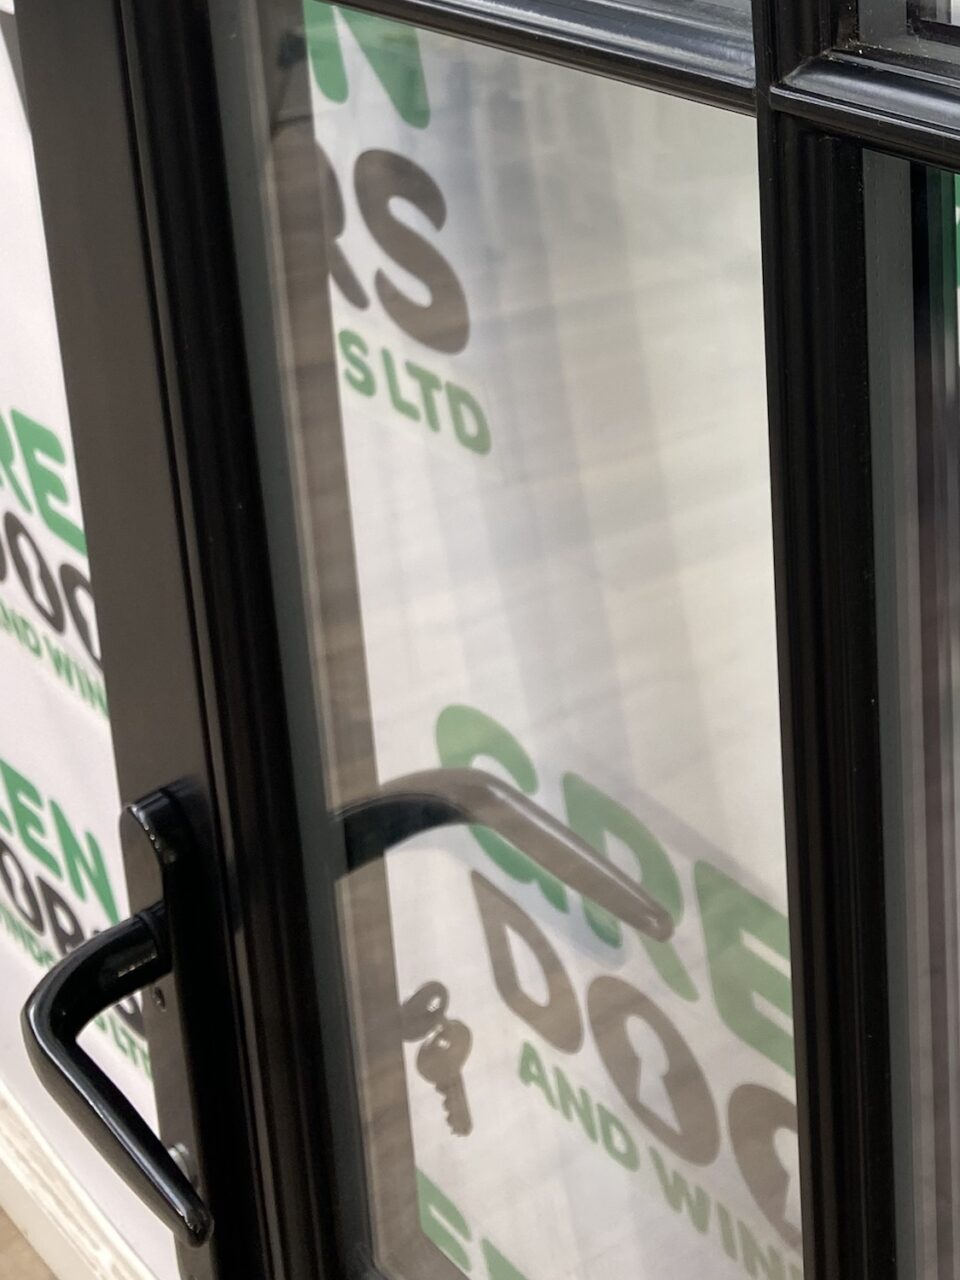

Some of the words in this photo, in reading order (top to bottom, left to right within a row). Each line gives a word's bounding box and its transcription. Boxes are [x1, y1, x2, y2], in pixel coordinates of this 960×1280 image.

[382, 348, 492, 457] LTD
[516, 1040, 641, 1172] AND
[648, 1144, 804, 1280] WIN
